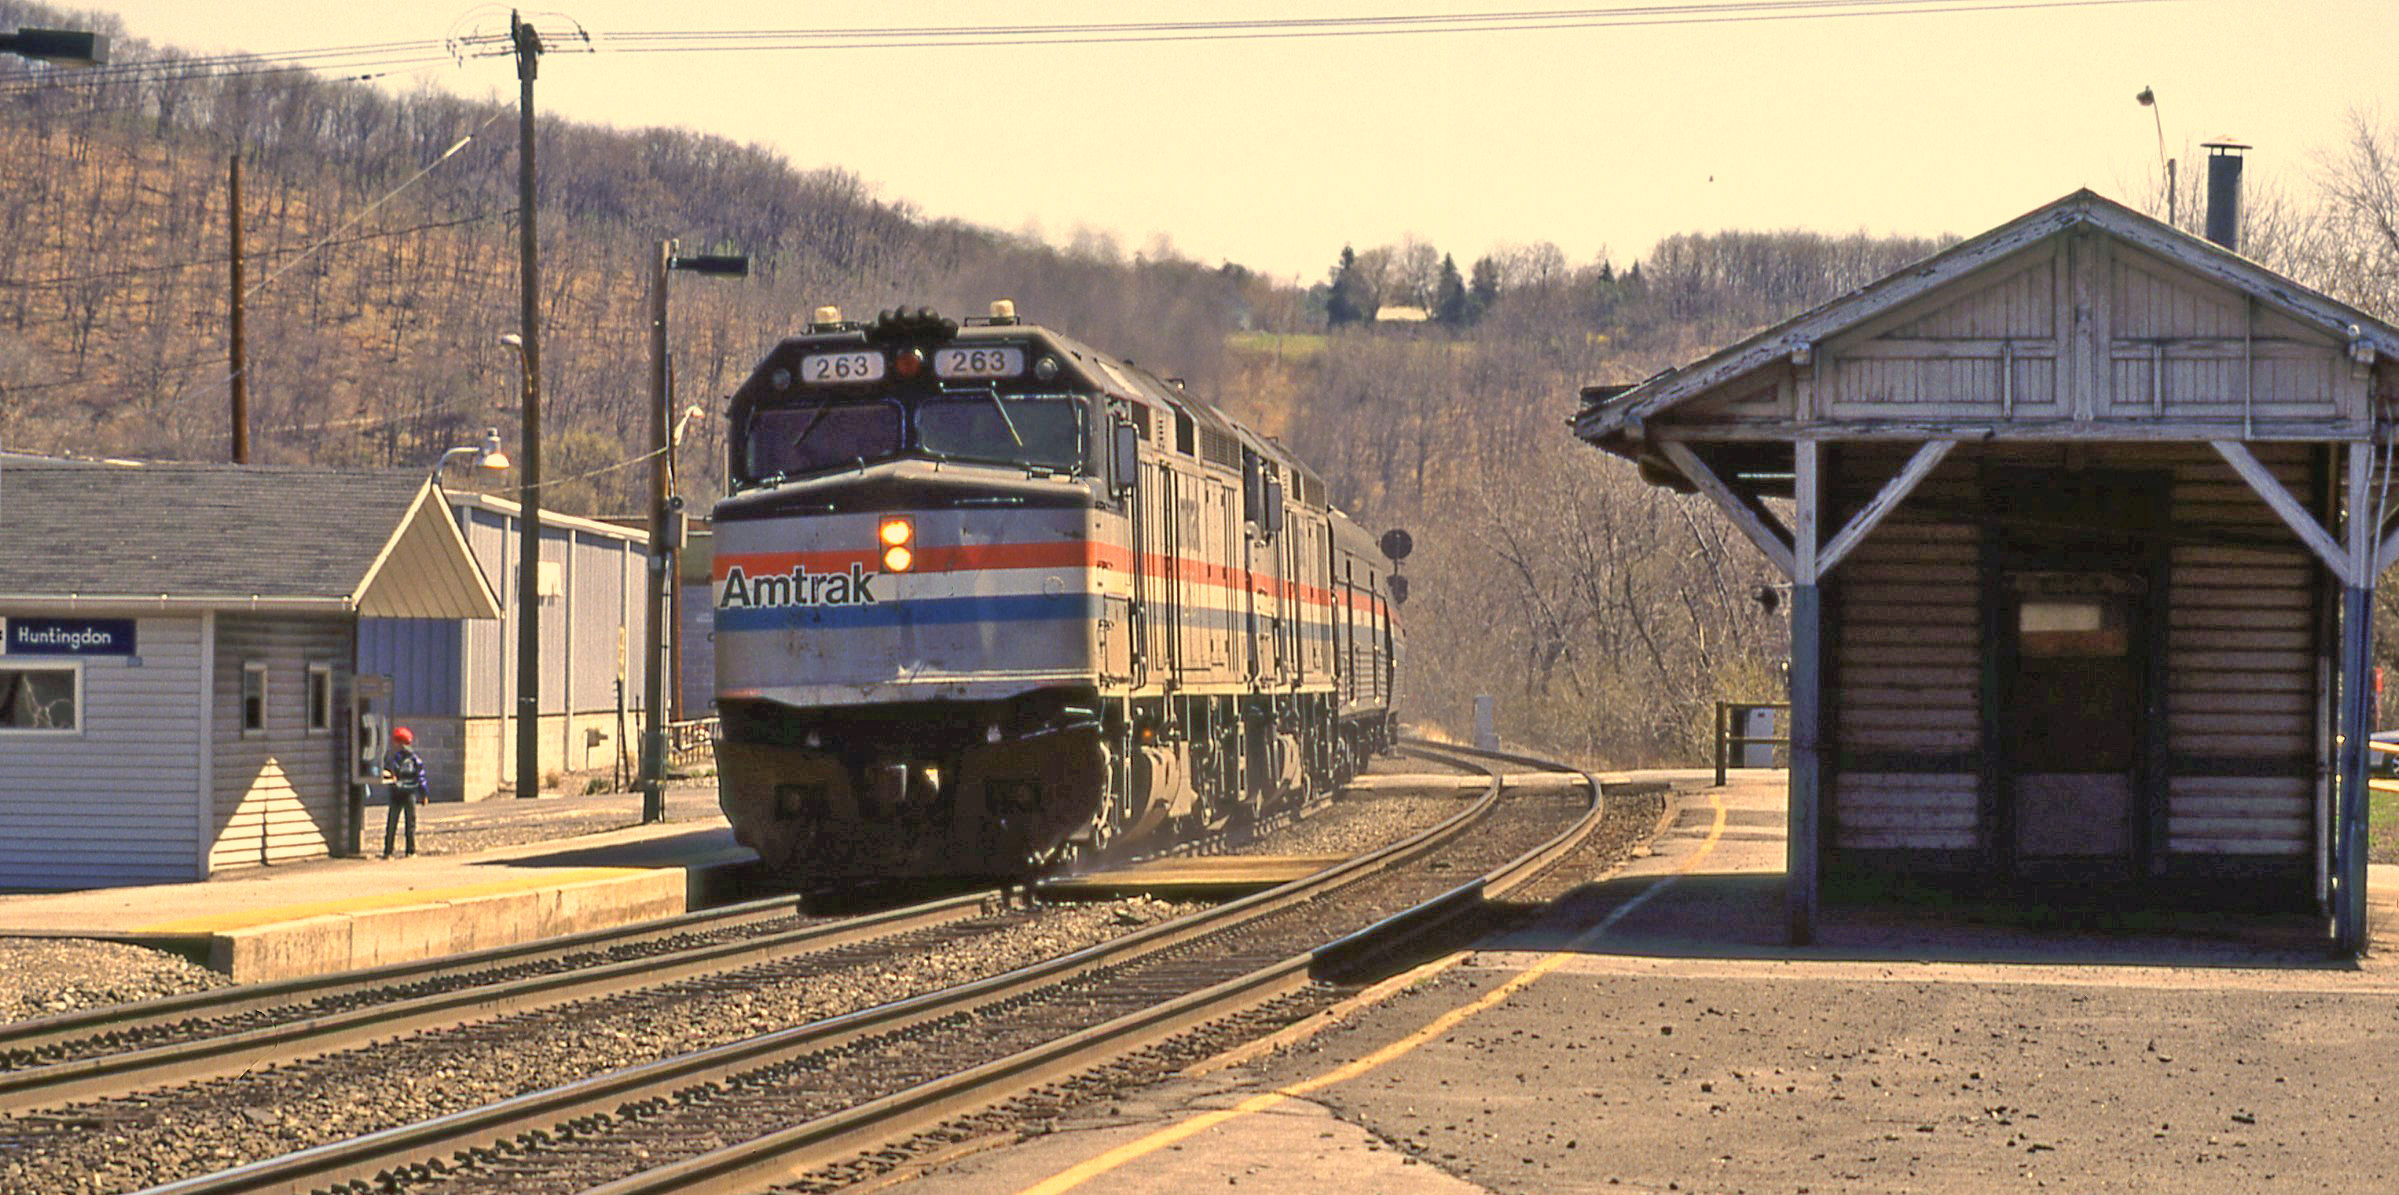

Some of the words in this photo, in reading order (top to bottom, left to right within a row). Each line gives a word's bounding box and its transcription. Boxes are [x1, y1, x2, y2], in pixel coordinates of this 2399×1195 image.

[816, 356, 869, 379] 263
[952, 351, 1006, 372] 263
[720, 562, 878, 608] Amtrak
[18, 626, 112, 650] Huntingdon
